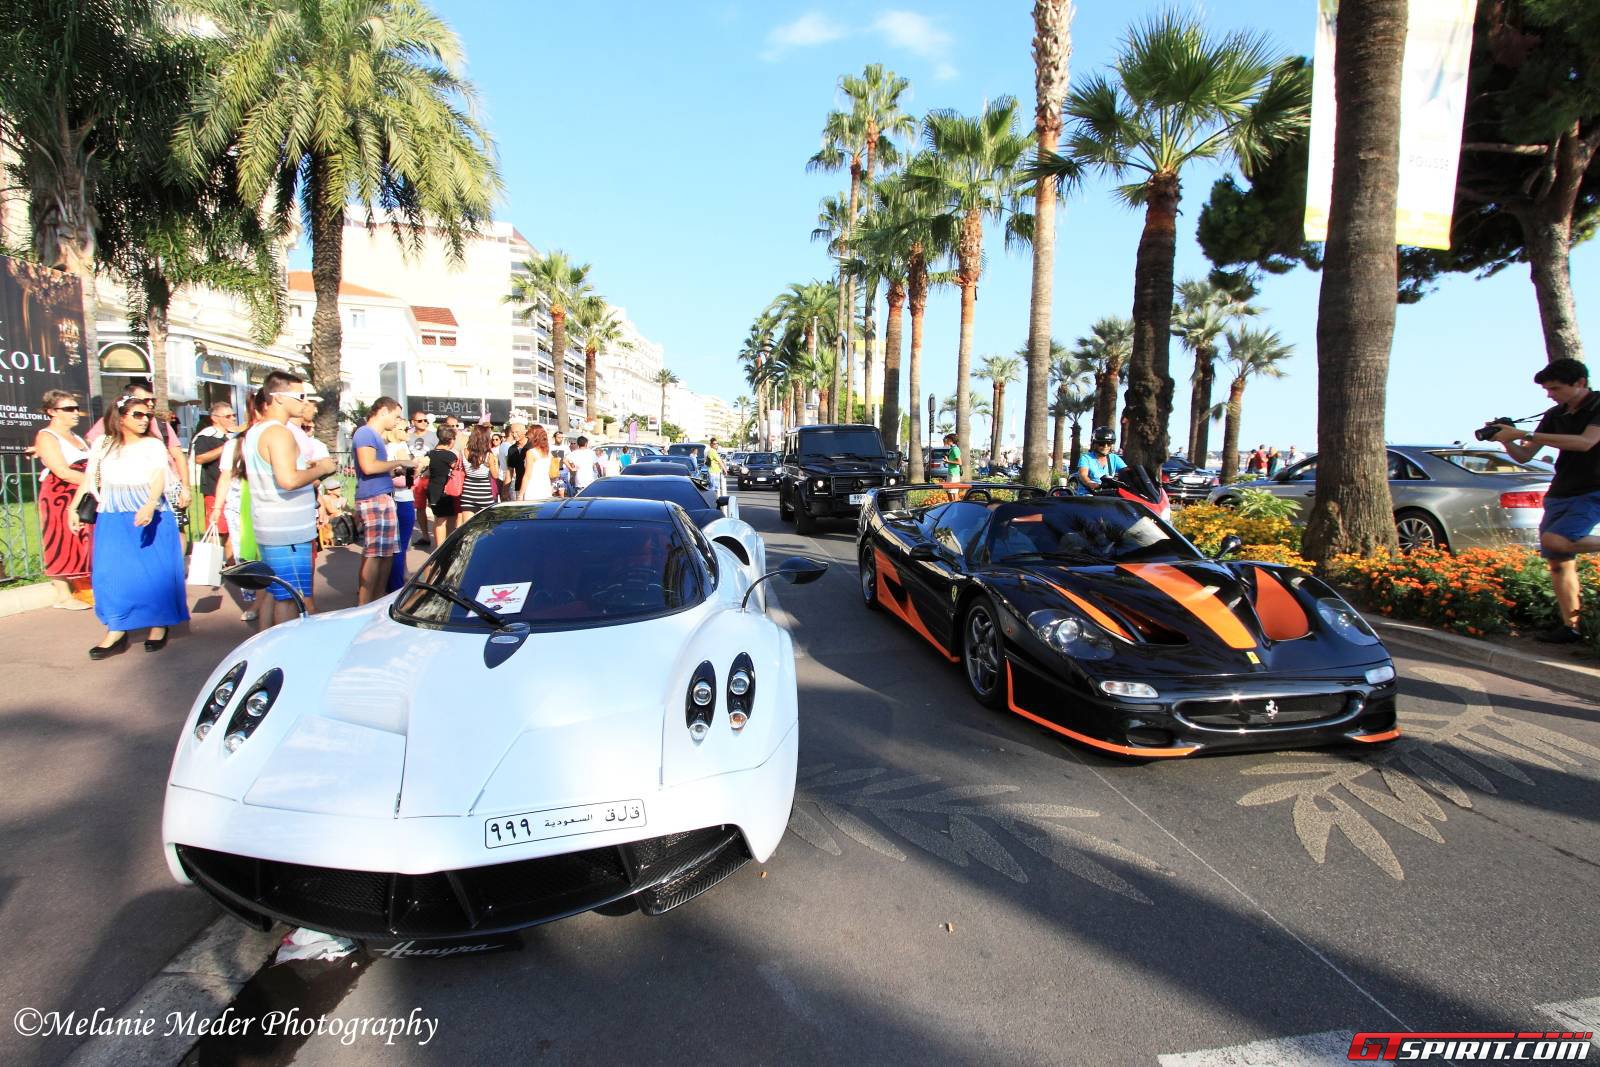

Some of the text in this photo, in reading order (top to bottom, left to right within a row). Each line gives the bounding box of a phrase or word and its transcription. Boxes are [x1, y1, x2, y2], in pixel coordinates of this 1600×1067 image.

[422, 401, 434, 412] LE
[9, 412, 42, 420] CARLTON
[374, 940, 504, 959] Huayra
